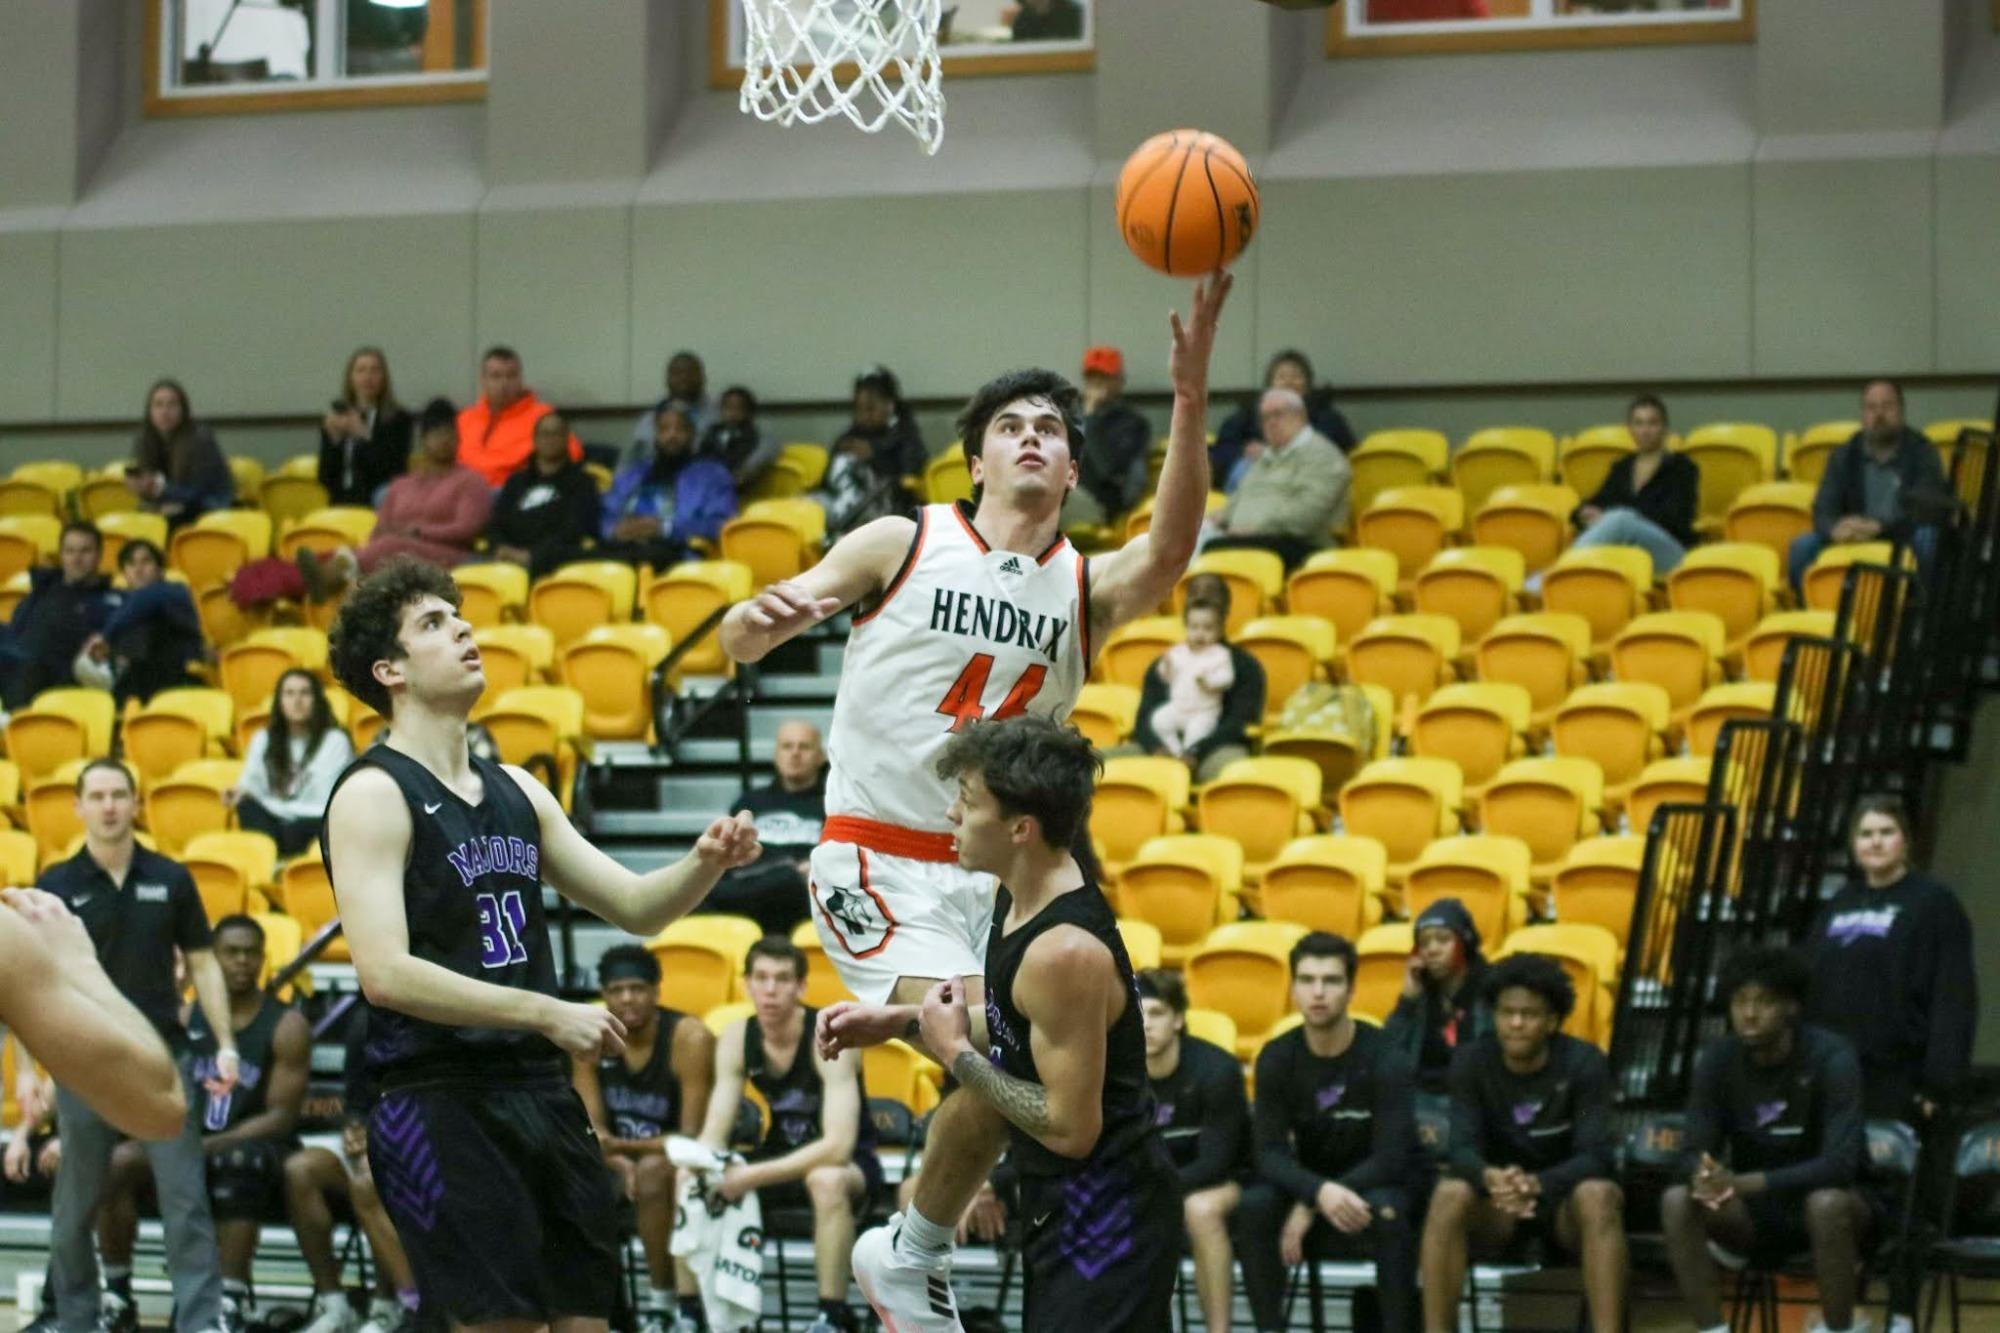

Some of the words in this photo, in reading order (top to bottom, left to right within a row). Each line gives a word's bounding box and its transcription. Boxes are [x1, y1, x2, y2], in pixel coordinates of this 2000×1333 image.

[929, 587, 1069, 663] HENDRIX
[934, 652, 1049, 733] 44
[476, 890, 528, 969] 31
